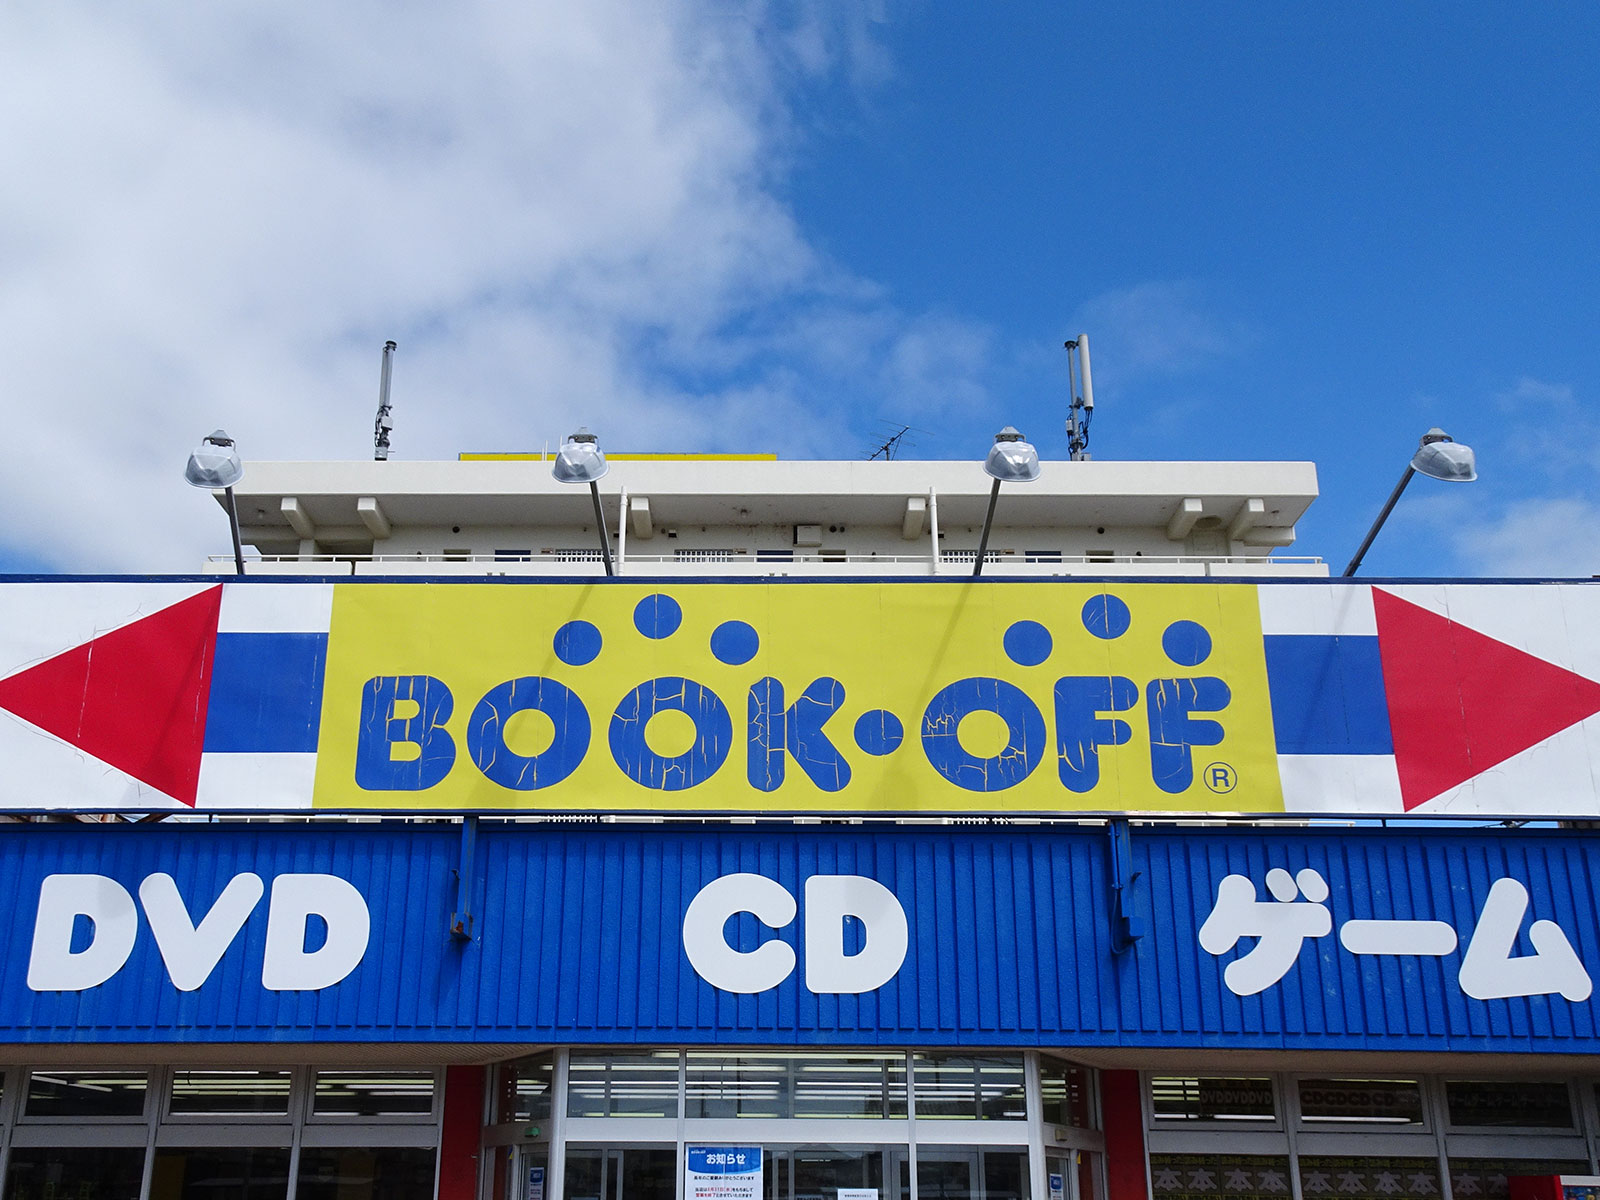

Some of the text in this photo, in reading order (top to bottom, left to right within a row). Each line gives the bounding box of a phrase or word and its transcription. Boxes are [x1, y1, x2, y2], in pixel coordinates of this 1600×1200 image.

[27, 872, 370, 992] DVD
[682, 872, 909, 994] CD
[1198, 868, 1593, 1002] ゲーム
[706, 1153, 746, 1165] お知らせ
